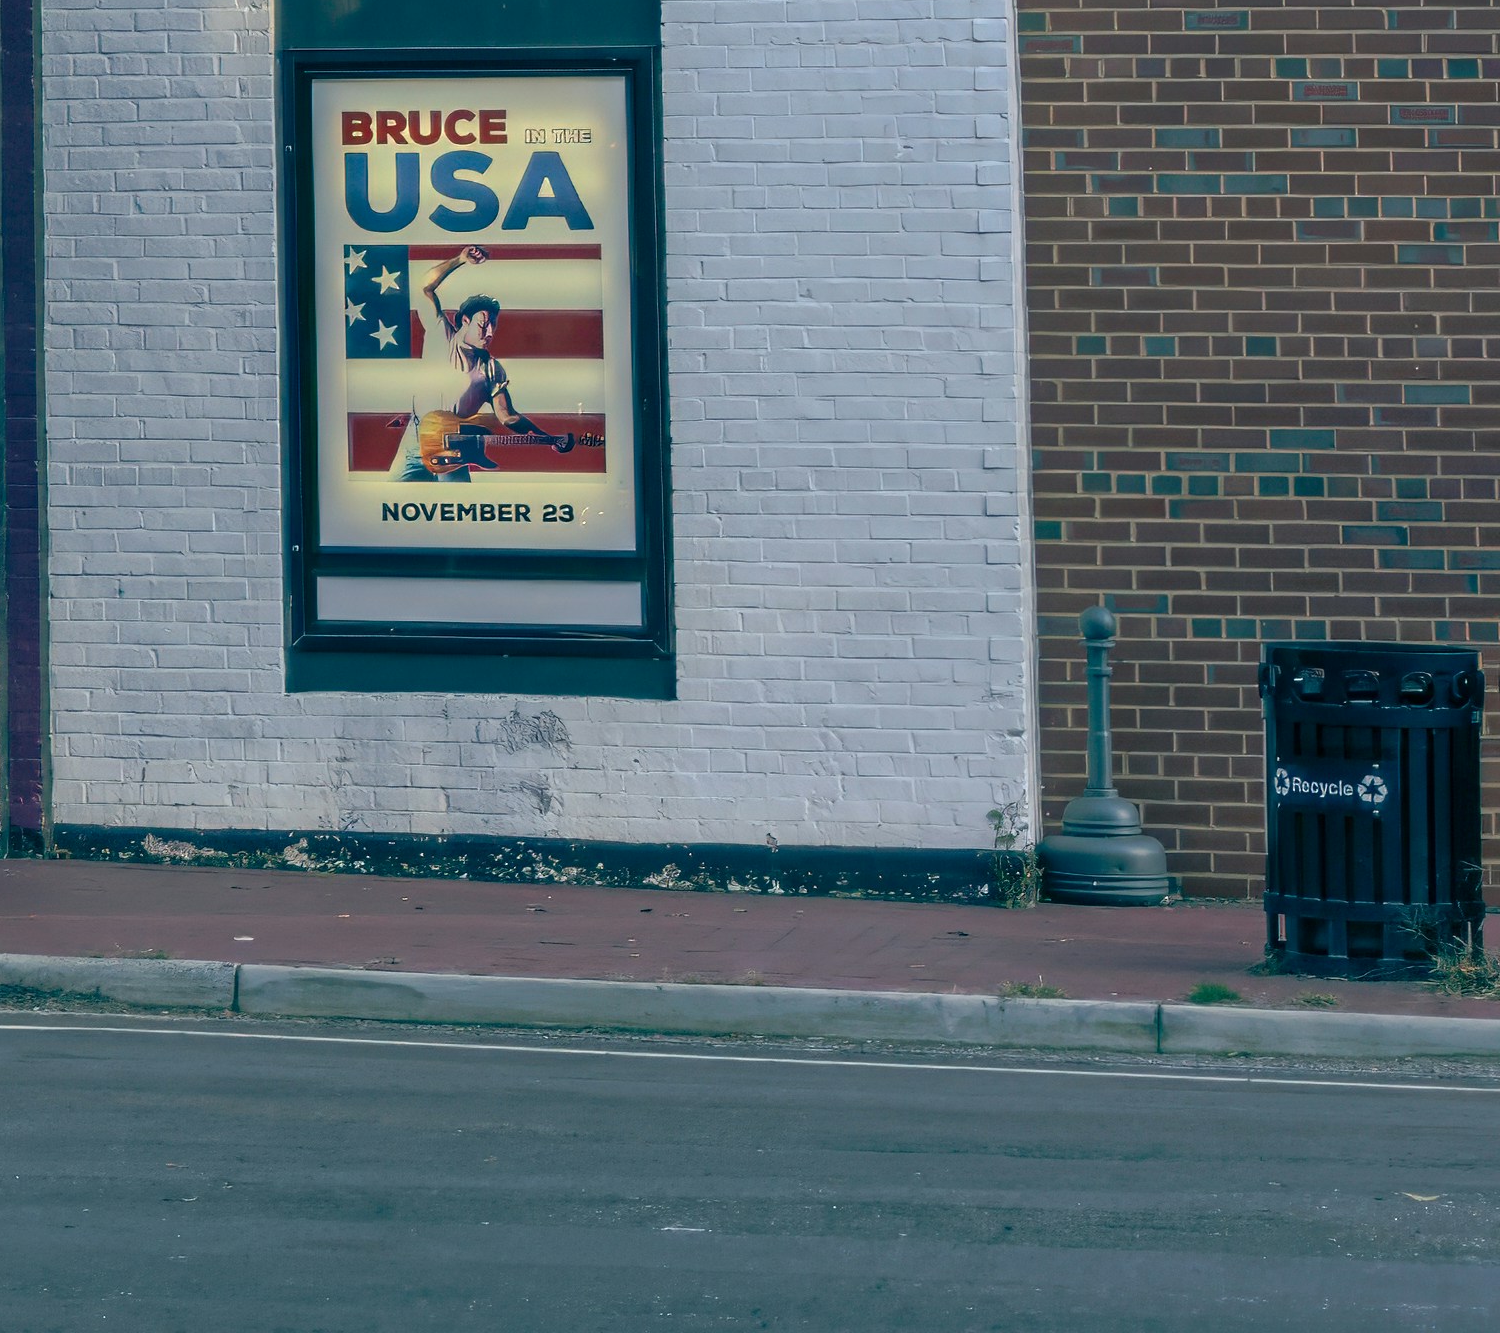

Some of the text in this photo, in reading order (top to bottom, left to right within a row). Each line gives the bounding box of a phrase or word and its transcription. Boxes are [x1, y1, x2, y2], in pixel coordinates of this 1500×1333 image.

[341, 109, 592, 146] BRUCE IN THE
[344, 149, 594, 233] USA
[381, 503, 575, 524] NOVEMBER 23
[1292, 777, 1354, 798] Recycle
